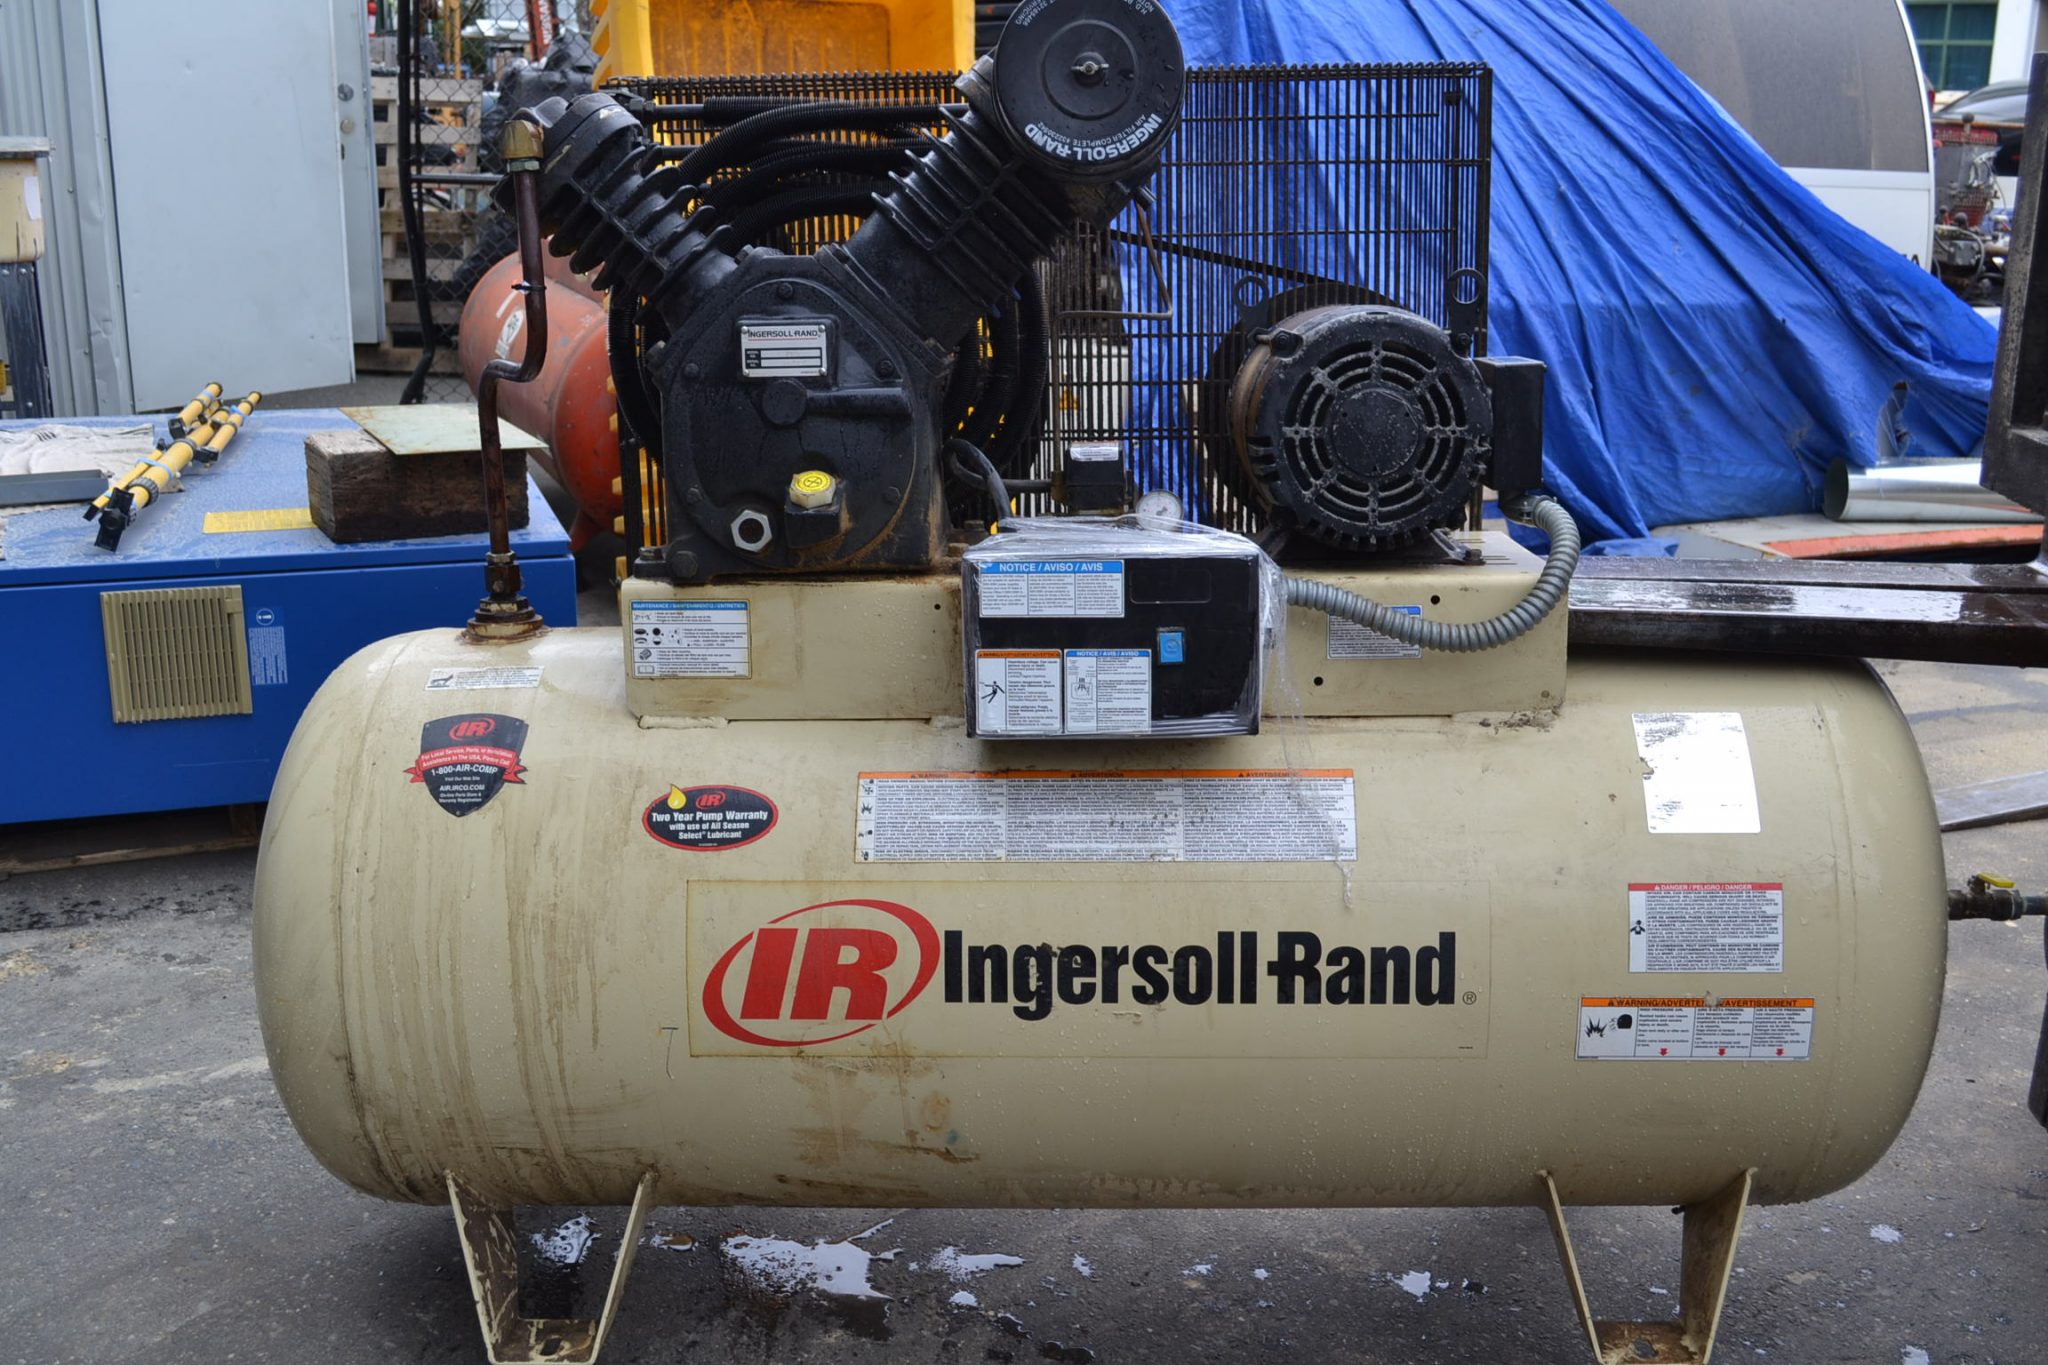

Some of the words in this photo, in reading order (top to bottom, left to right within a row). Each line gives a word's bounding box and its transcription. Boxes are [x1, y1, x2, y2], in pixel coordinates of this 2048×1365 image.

[1133, 113, 1147, 127] AIR
[1112, 123, 1136, 142] FILTER
[1072, 137, 1112, 148] COMPLETE
[999, 563, 1036, 572] NOTICE
[1038, 563, 1042, 572] /
[1044, 563, 1074, 571] AVISO
[1074, 563, 1079, 571] /
[1081, 562, 1103, 571] AVIS
[431, 764, 499, 776] 1-800-AIR-COMP
[652, 812, 671, 822] Two
[672, 812, 693, 821] Year
[696, 811, 723, 823] Pump
[725, 810, 768, 821] Warranty
[702, 822, 710, 830] of
[707, 831, 742, 839] Lubricant
